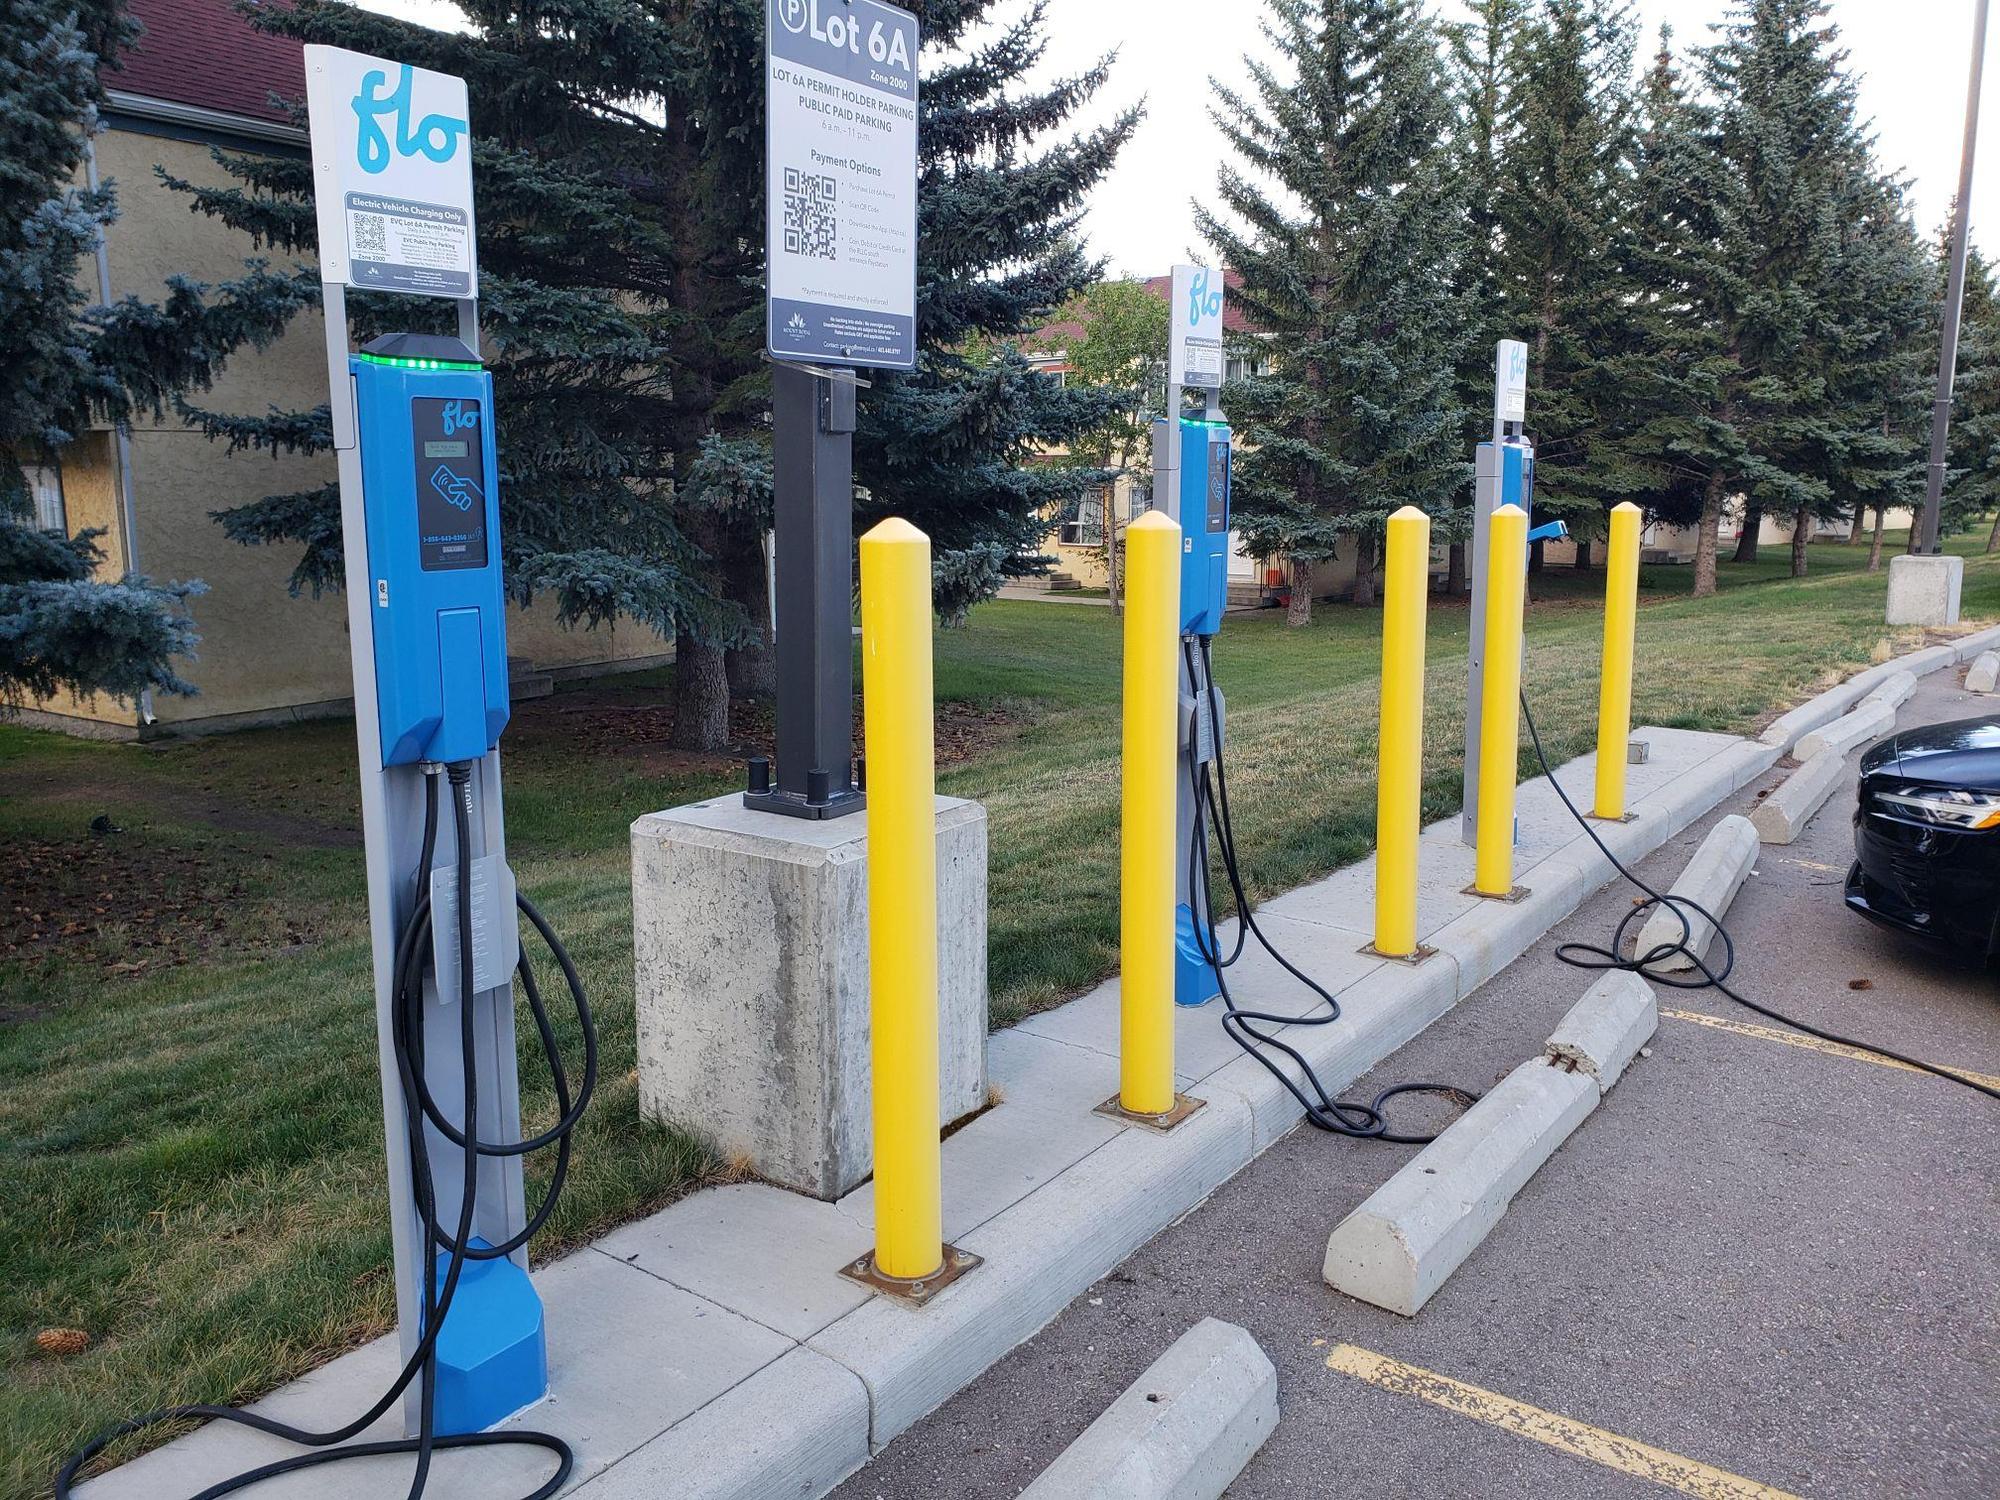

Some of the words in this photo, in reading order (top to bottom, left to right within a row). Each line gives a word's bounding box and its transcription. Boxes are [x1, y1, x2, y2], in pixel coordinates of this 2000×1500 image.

[810, 0, 860, 54] Lot
[868, 20, 911, 72] 6A
[773, 66, 790, 84] LOT
[792, 72, 805, 89] 6A
[807, 77, 840, 99] PERMIT
[842, 88, 876, 110] HOLDER
[879, 99, 914, 121] PARKING
[870, 70, 888, 84] Zone
[889, 76, 908, 90] 2000
[350, 63, 466, 174] flo
[799, 95, 831, 116] PUBLIC
[833, 105, 853, 122] PAID
[856, 111, 892, 133] PARKING
[811, 149, 847, 172] Payment
[850, 158, 881, 180] Options
[352, 198, 381, 209] Electric
[382, 202, 409, 213] Vehicle
[410, 206, 443, 220] Charging
[444, 212, 462, 222] Only
[390, 218, 402, 226] EVC
[424, 222, 442, 231] Permit
[444, 226, 465, 235] Parking
[1190, 268, 1222, 326] flo
[442, 400, 480, 436] flo
